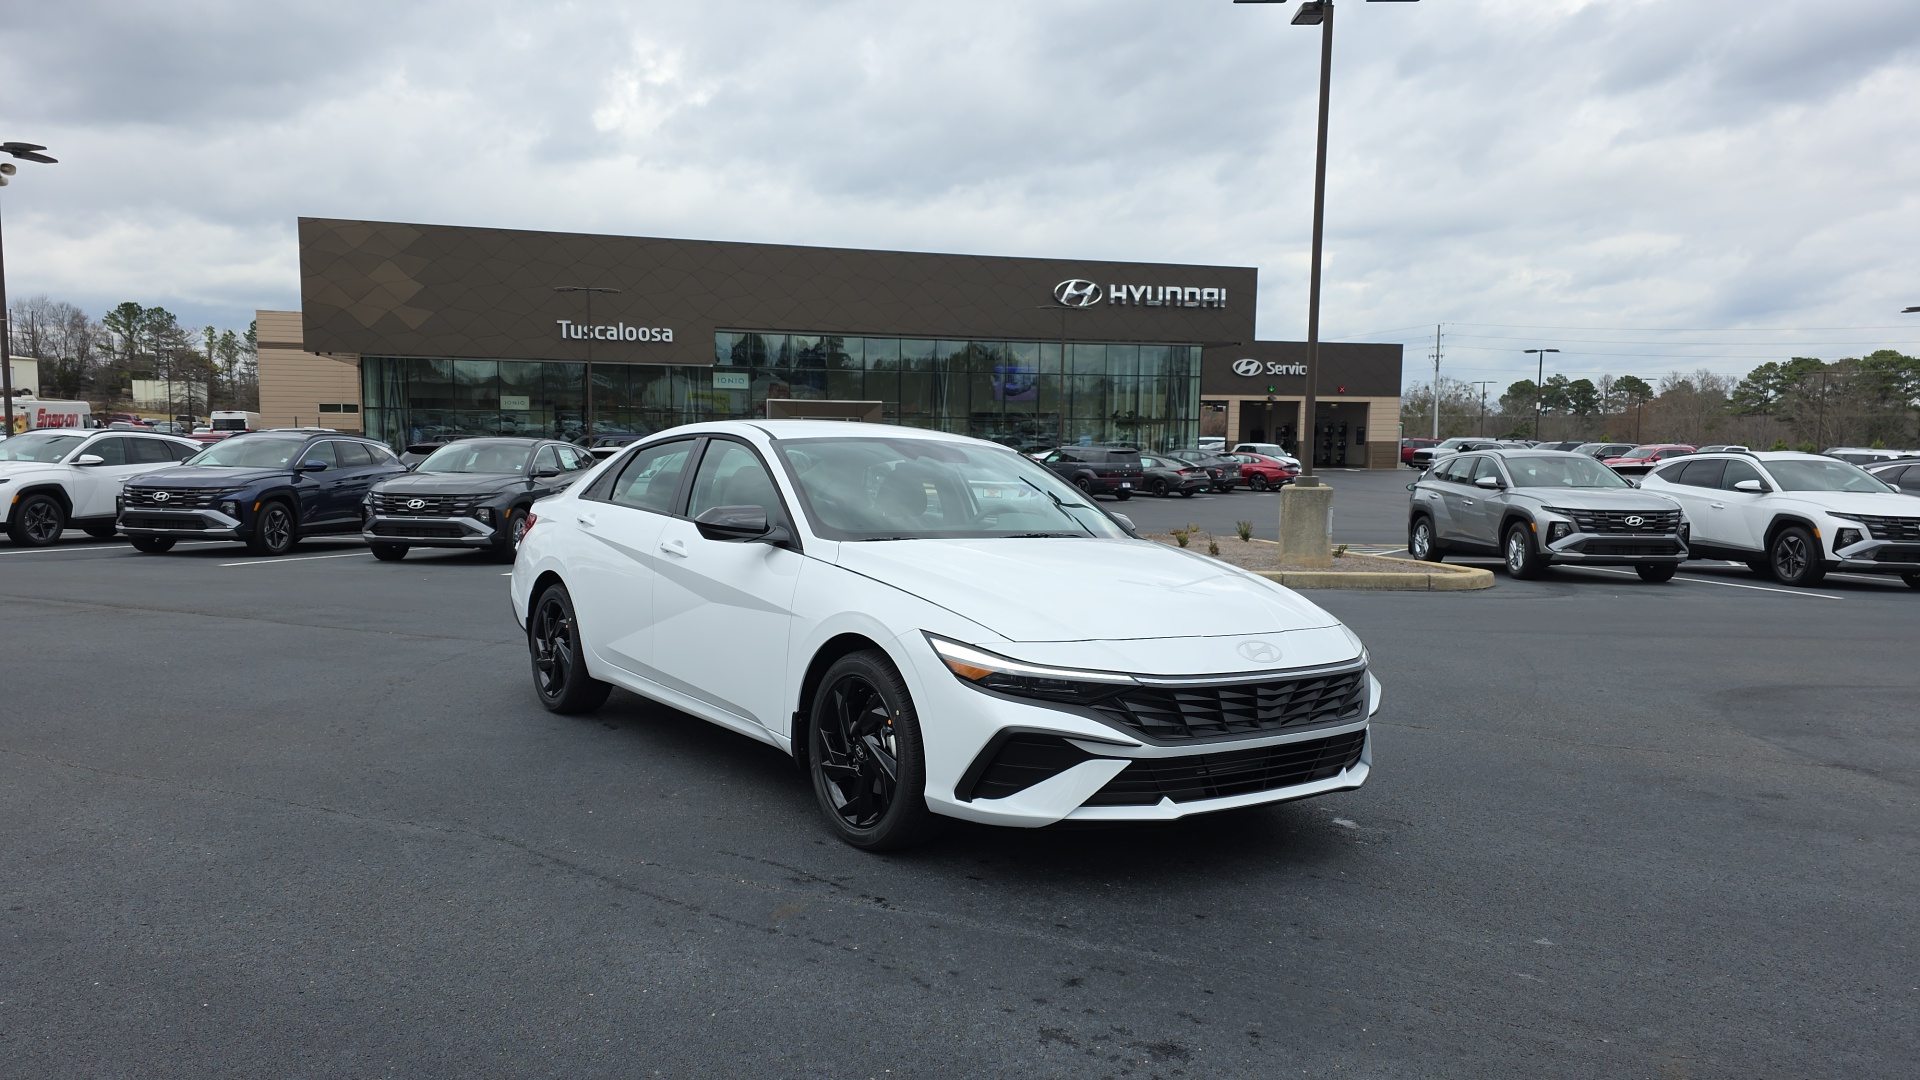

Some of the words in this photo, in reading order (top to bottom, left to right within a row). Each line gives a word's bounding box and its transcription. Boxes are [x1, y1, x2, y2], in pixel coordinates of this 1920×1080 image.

[1109, 284, 1226, 308] HYUNDAI
[556, 320, 673, 342] Tuscaloosa
[1266, 361, 1307, 375] Servic
[36, 408, 79, 429] Snap-on
